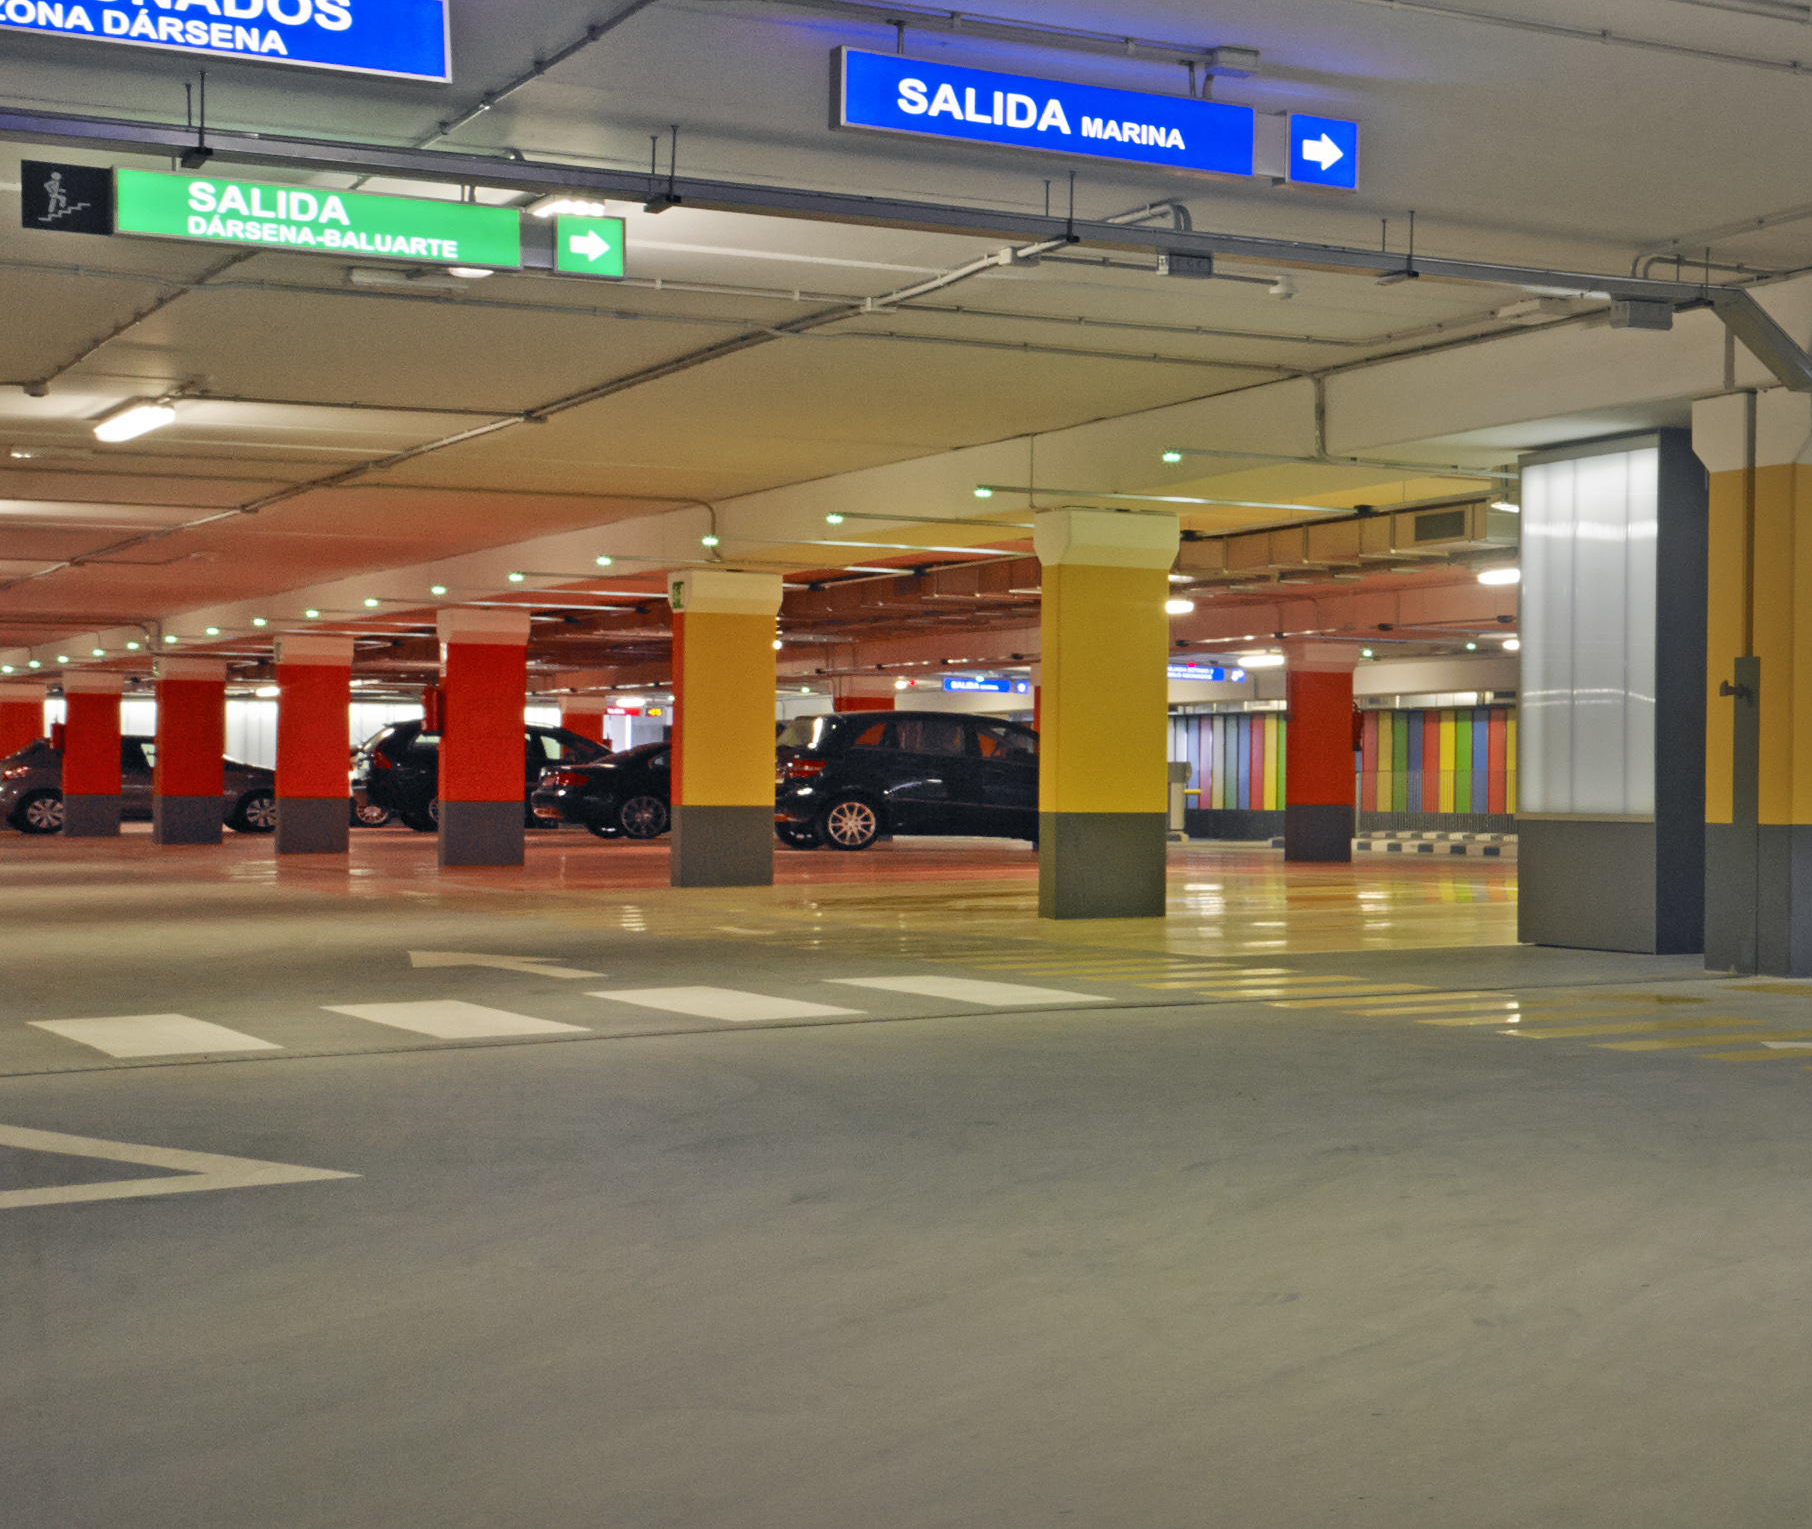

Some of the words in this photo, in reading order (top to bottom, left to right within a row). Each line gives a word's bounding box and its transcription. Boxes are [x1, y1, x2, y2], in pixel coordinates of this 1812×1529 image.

[103, 8, 288, 55] DÁRSENA
[897, 77, 1072, 135] SALIDA
[1081, 116, 1186, 150] MARINA
[188, 181, 351, 226] SALIDA
[188, 214, 458, 259] DÁRSENA-BALUARTE
